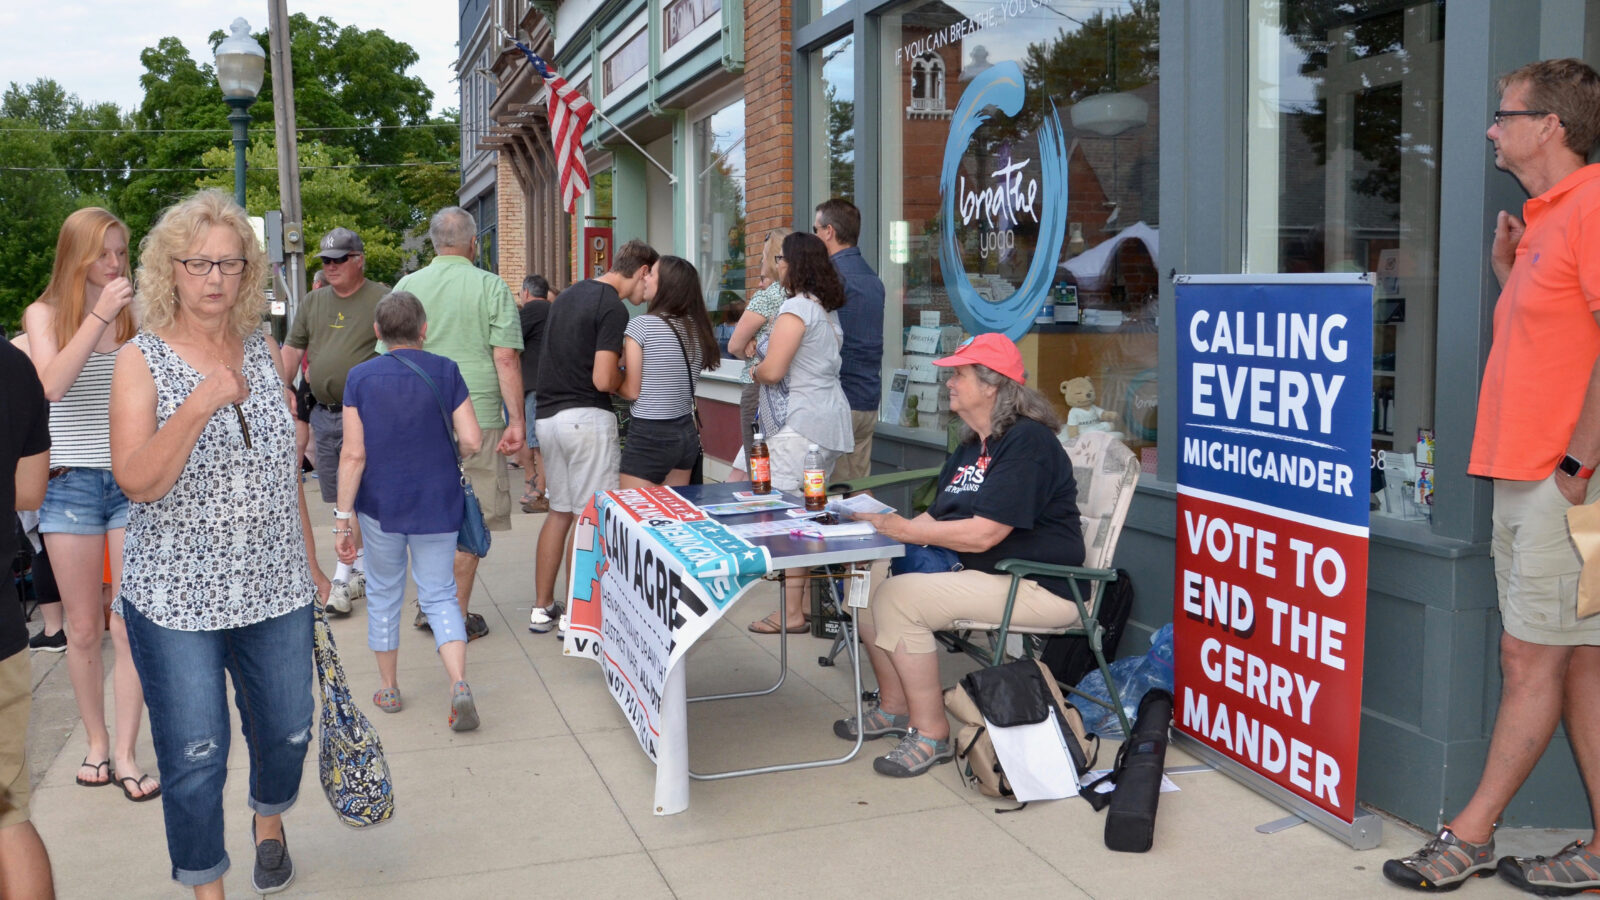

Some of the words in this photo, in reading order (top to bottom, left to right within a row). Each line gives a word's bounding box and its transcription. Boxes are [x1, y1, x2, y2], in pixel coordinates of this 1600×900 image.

[895, 48, 902, 66] IF
[904, 38, 924, 62] YOU
[926, 27, 948, 53] CAN
[950, 9, 999, 43] BREATHE,
[1001, 0, 1027, 21] YOU
[960, 156, 1039, 229] breathe
[594, 236, 605, 279] OPE
[980, 229, 1015, 259] yoga
[1189, 309, 1348, 363] CALLING
[1192, 362, 1346, 434] EVERY
[1183, 437, 1354, 497] MICHIGANDER
[604, 506, 629, 583] CAN
[654, 524, 731, 601] DEMOCRATS
[1184, 510, 1277, 579] VOTE
[1289, 537, 1347, 598] TO
[1183, 569, 1254, 632] END
[1266, 596, 1347, 671] THE
[608, 669, 625, 697] NOT
[1200, 637, 1321, 725] GERRY
[1182, 686, 1341, 808] MANDER
